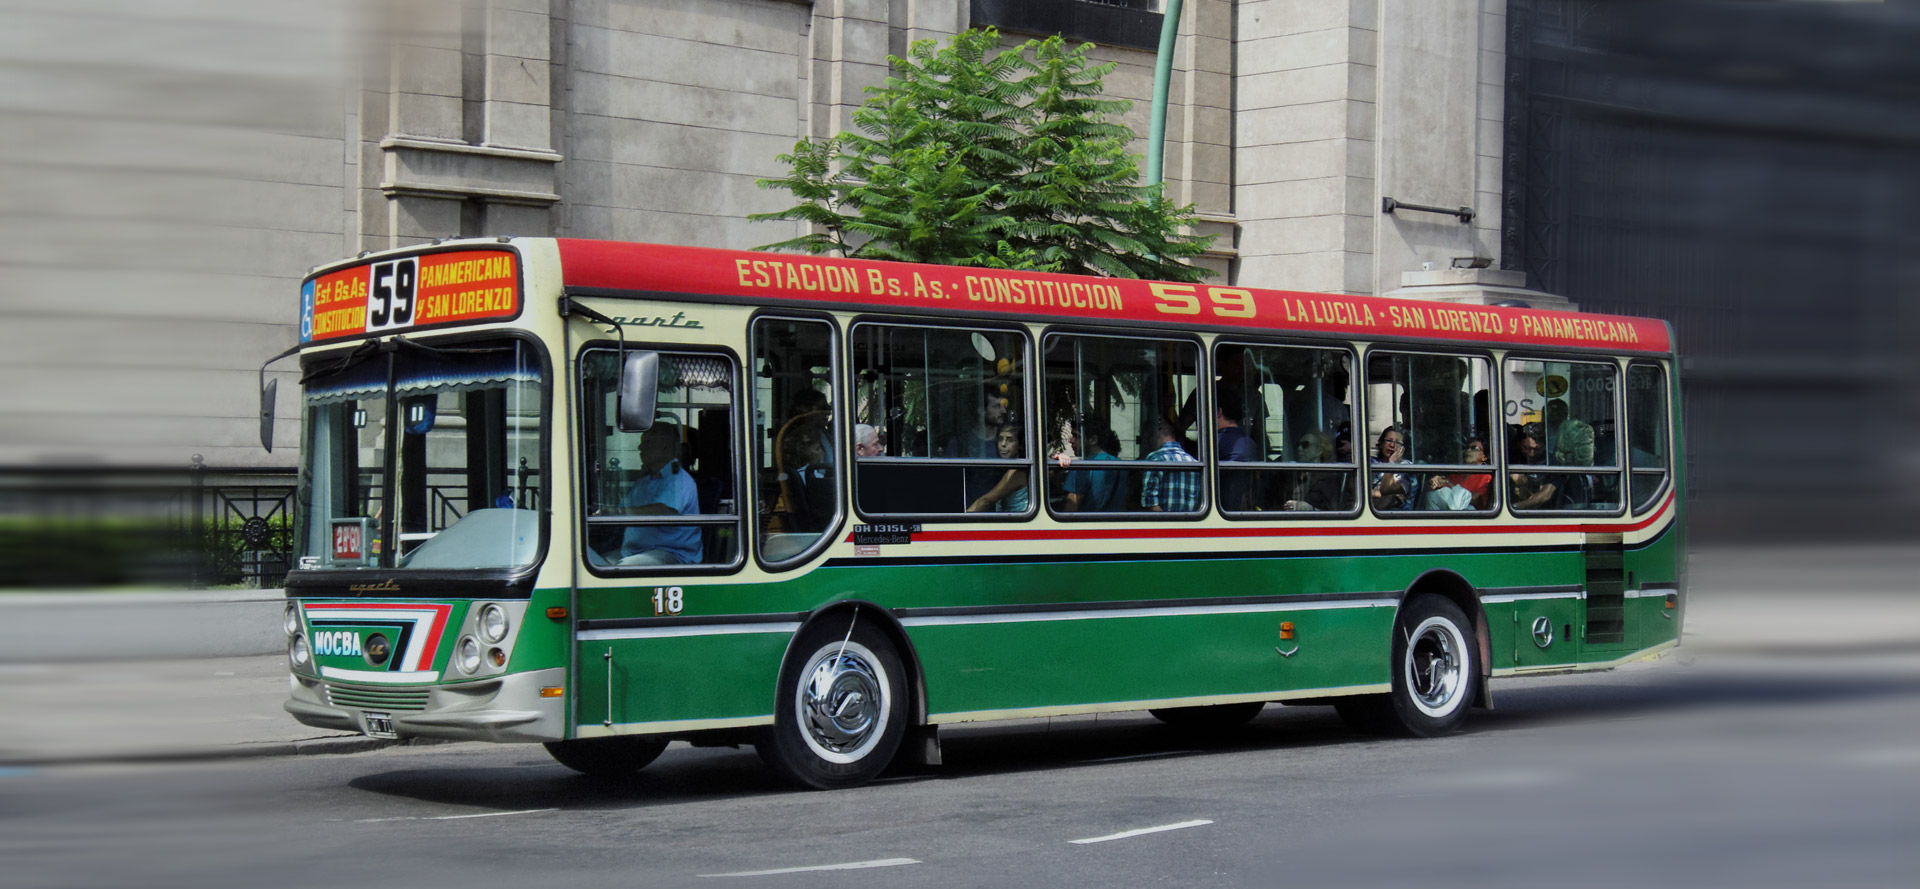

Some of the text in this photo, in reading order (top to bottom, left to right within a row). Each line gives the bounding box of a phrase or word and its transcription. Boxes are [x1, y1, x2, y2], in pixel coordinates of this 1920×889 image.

[420, 256, 511, 289] PANAMERICANA
[735, 259, 860, 294] ESTACION
[965, 275, 1123, 311] CONSTITUCION
[315, 277, 333, 306] Est.
[371, 260, 415, 327] 59
[427, 297, 450, 318] SAN
[452, 287, 512, 315] LORENZO
[1149, 283, 1257, 318] 59
[313, 305, 366, 335] CONSTITUCION
[1283, 298, 1310, 323] LA
[1310, 300, 1376, 327] LUCILA
[1389, 305, 1427, 329] SAN
[1428, 308, 1503, 335] LORENZO
[1521, 314, 1639, 343] PANAMERICANA
[856, 534, 909, 544] Mercedes-Benz
[651, 586, 684, 617] 18
[314, 631, 362, 656] MOCBA
